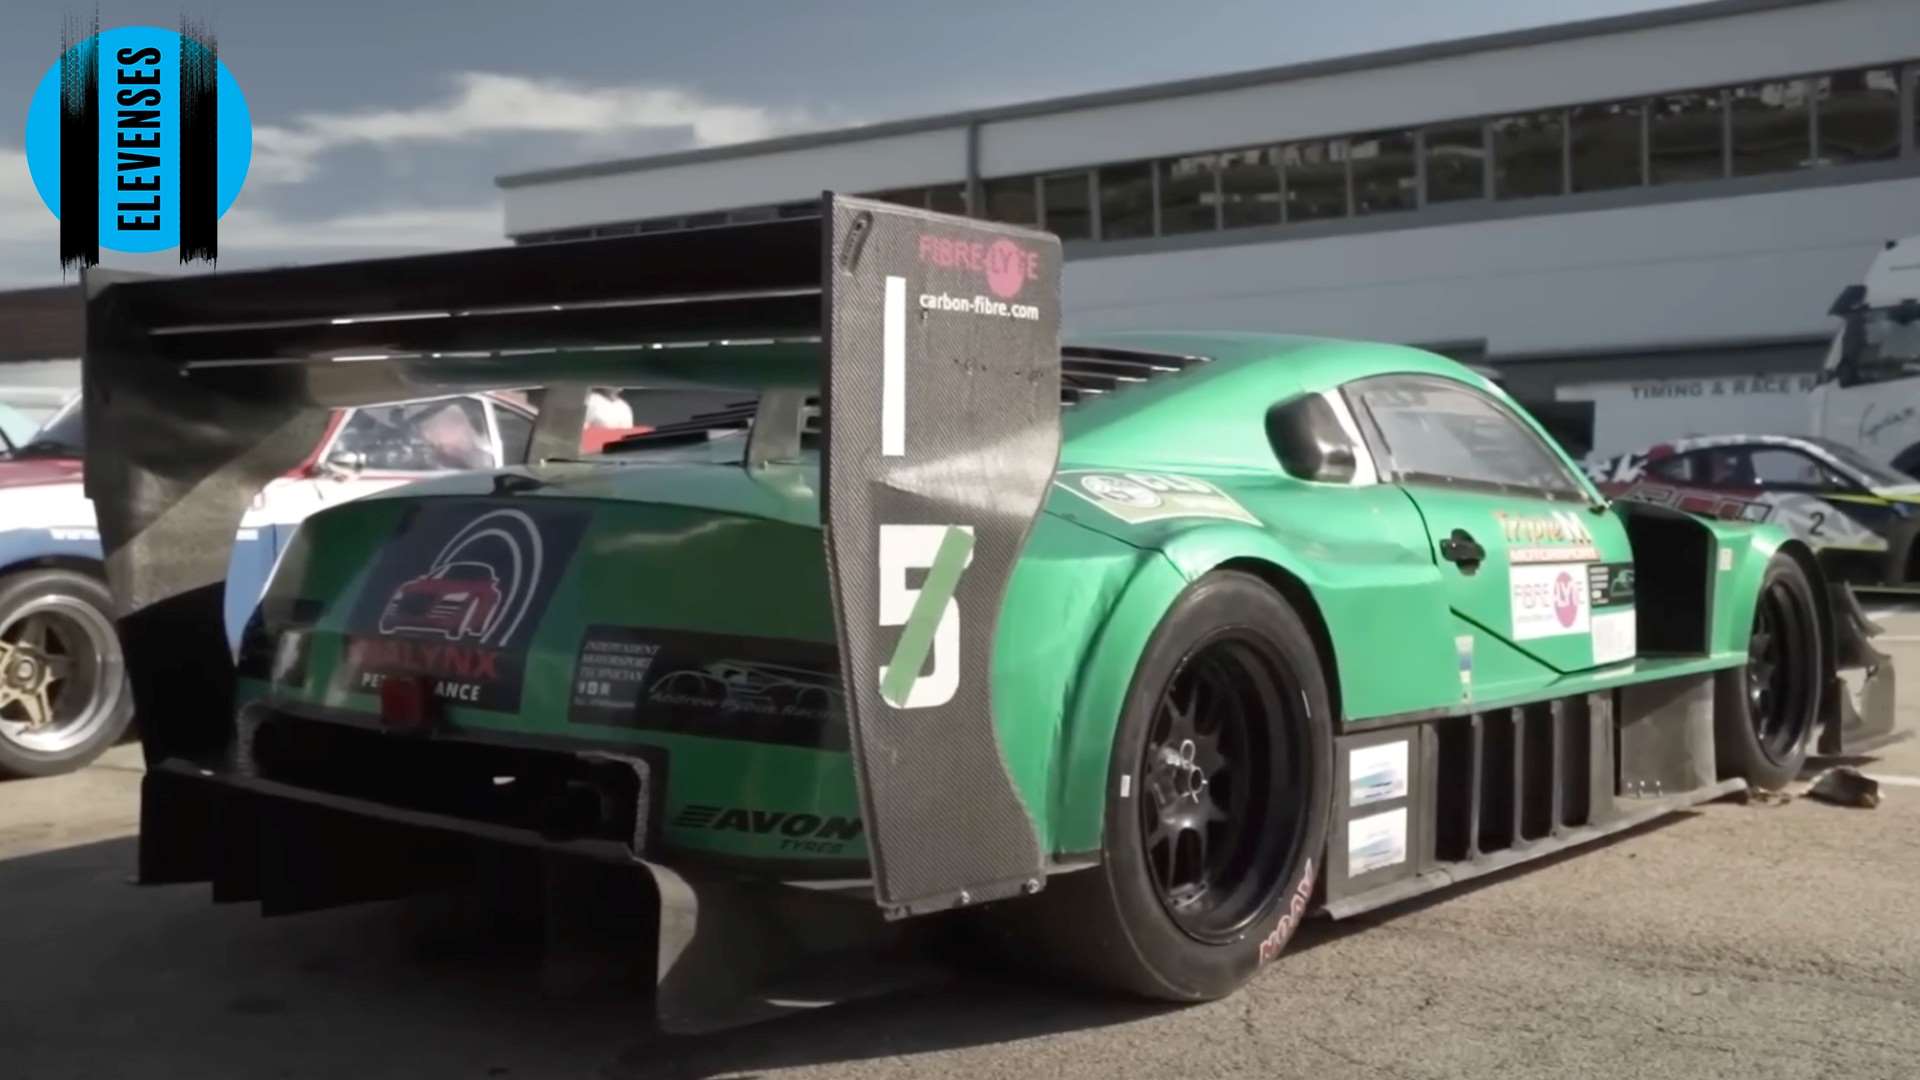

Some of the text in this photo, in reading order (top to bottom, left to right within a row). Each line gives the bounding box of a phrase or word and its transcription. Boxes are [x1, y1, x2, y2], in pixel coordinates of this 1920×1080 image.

[919, 292, 1040, 321] carbon-fibre.com
[1632, 386, 1704, 400] TIMING
[1732, 379, 1791, 396] RACE
[1808, 511, 1826, 536] 2
[711, 807, 863, 841] AVON
[779, 838, 847, 855] TYRES
